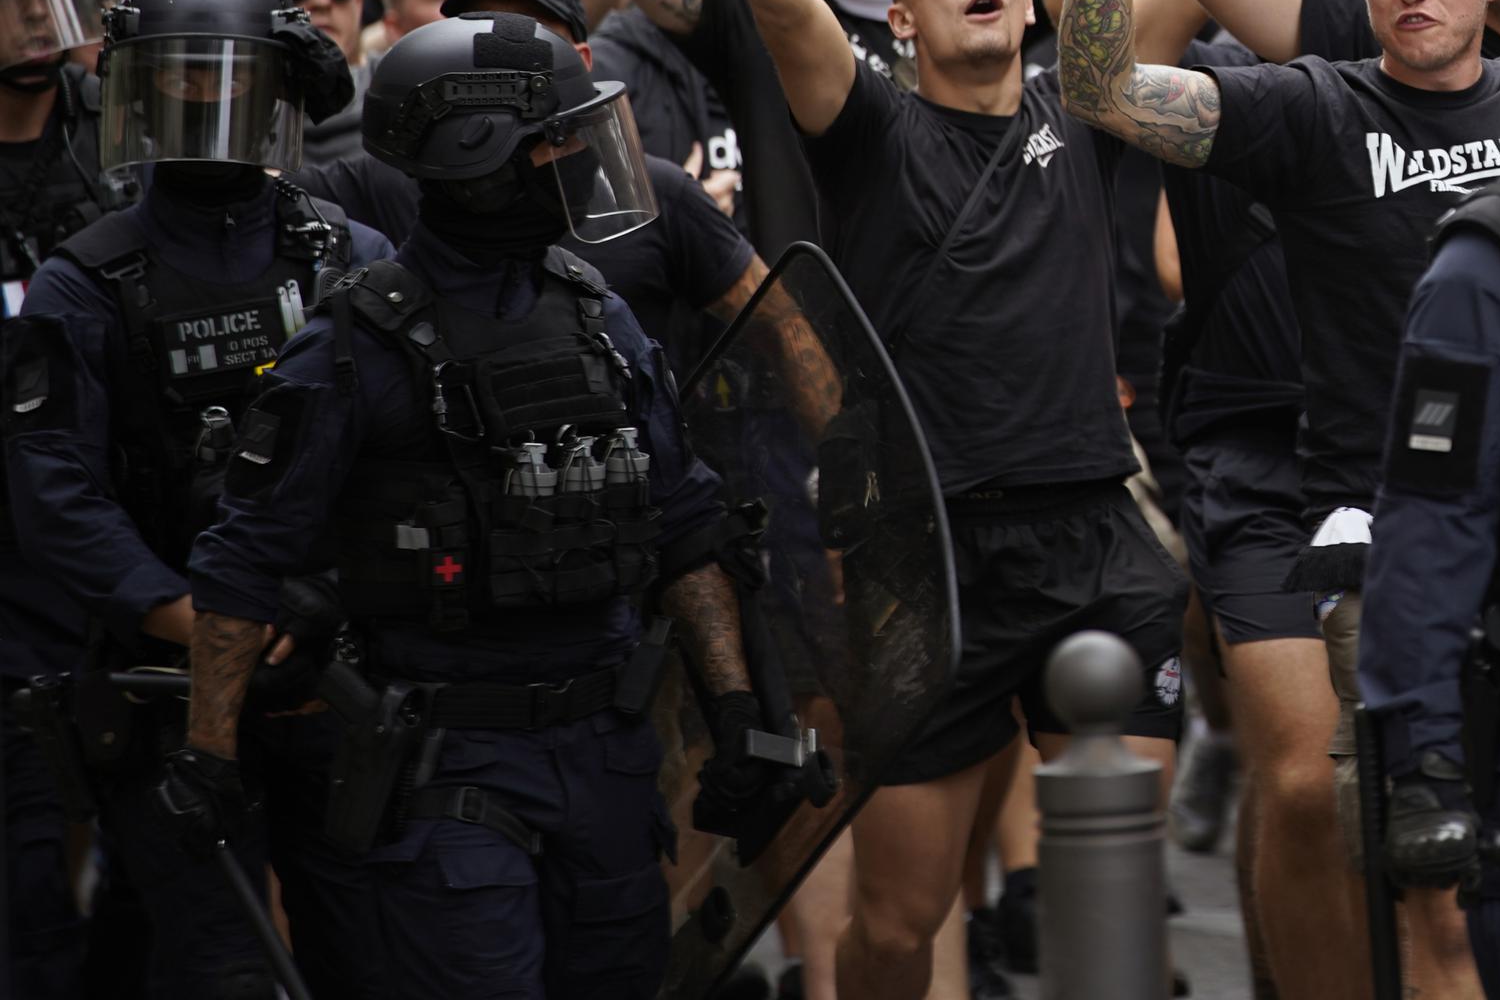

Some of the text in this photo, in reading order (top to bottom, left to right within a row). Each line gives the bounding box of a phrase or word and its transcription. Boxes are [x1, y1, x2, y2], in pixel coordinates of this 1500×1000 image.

[178, 310, 261, 342] POLICE
[243, 335, 269, 349] POS
[224, 351, 257, 365] SECT
